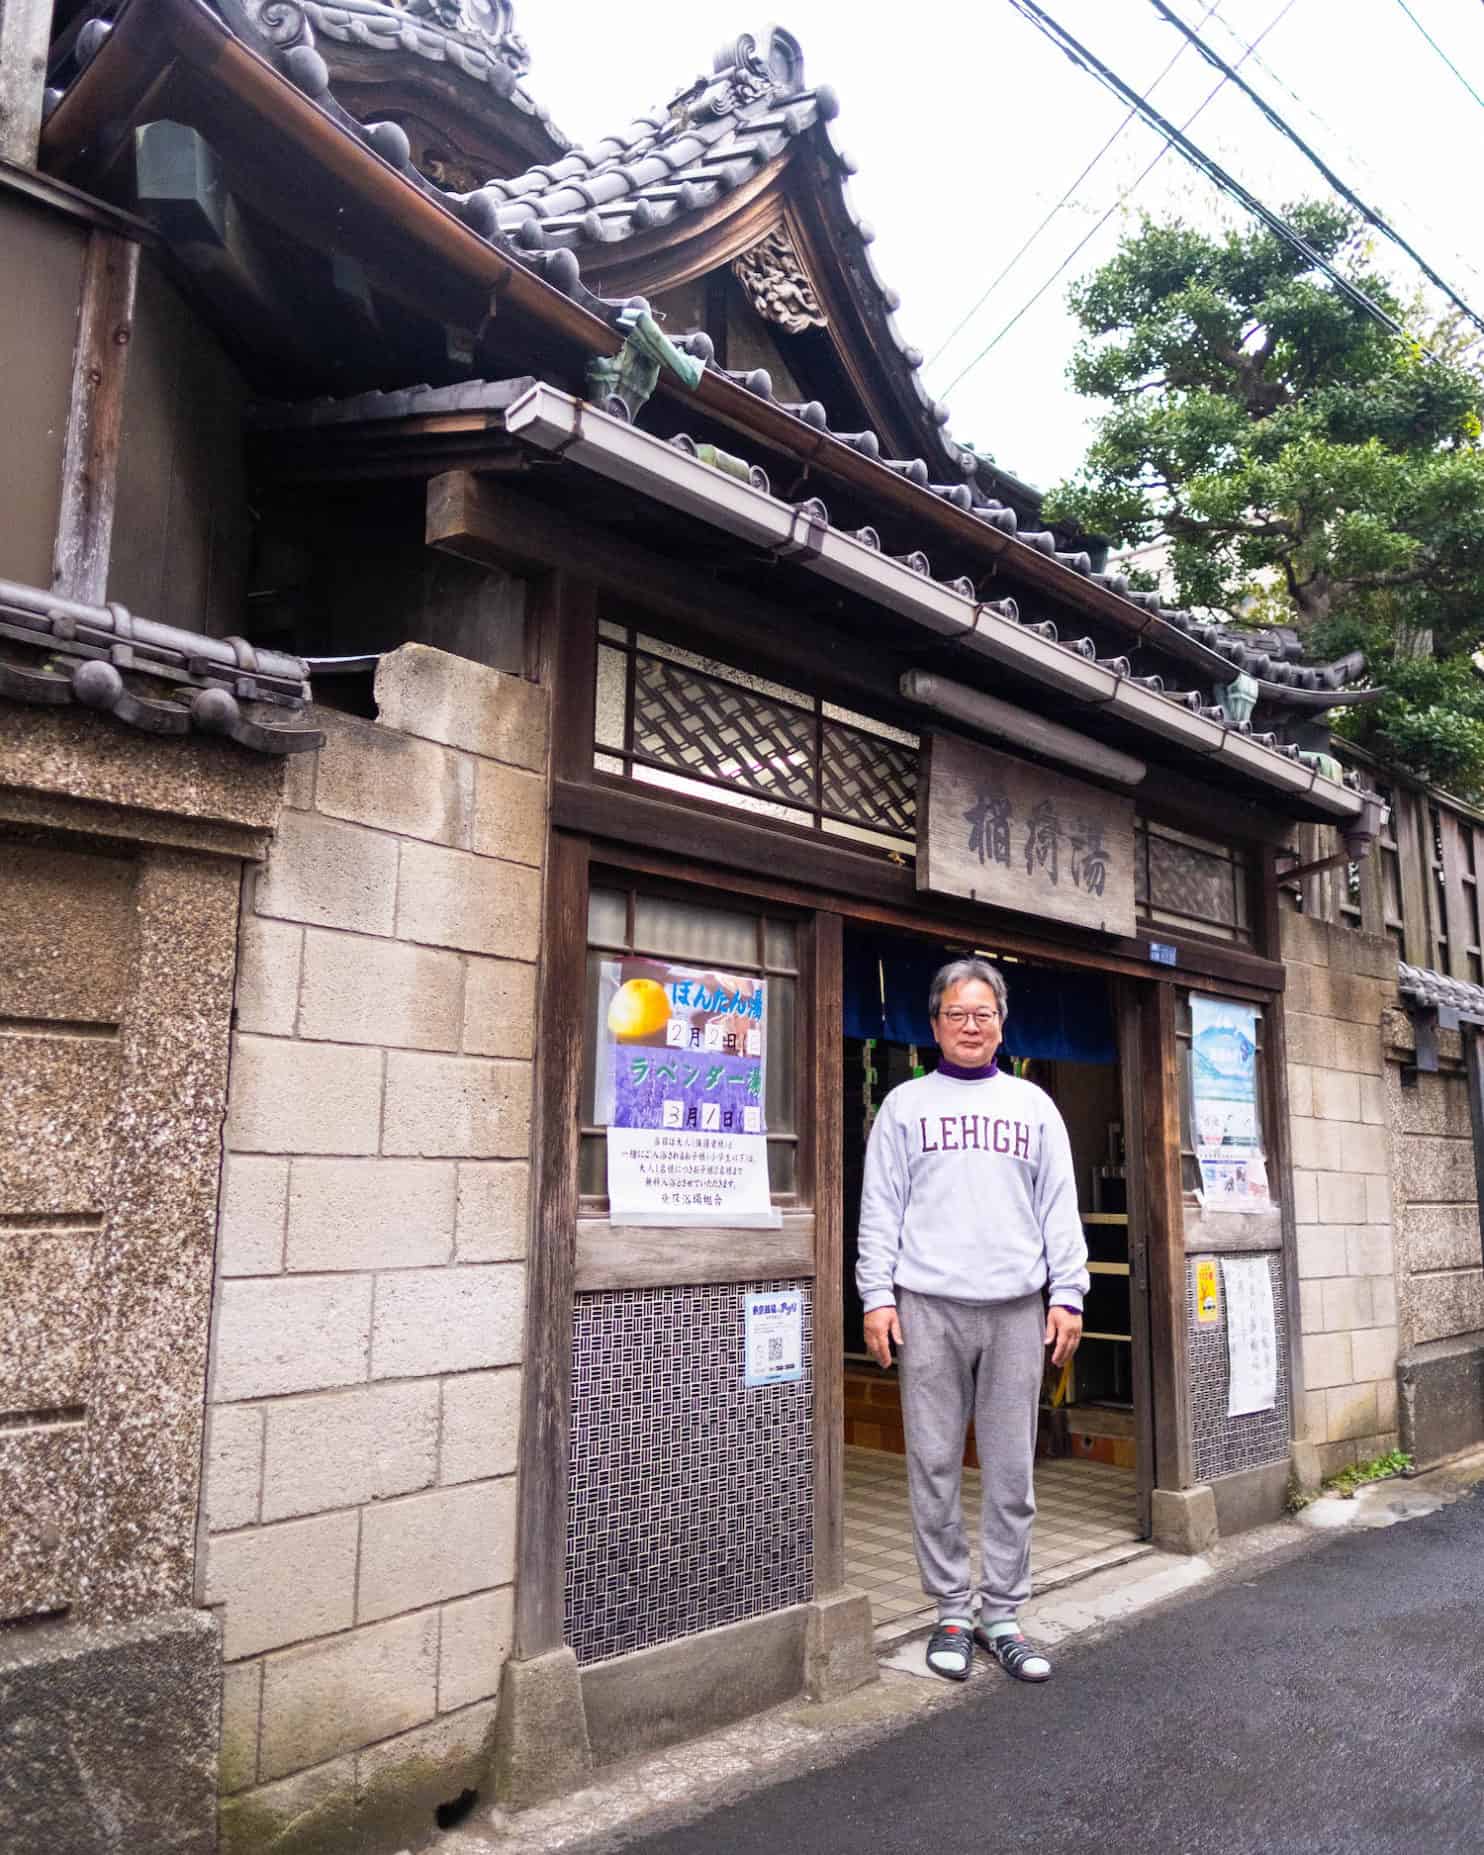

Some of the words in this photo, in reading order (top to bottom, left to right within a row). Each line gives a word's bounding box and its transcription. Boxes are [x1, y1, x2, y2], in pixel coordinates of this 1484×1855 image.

[630, 1058, 761, 1096] ラベンダー湯
[920, 1114, 1030, 1160] LEHIGH
